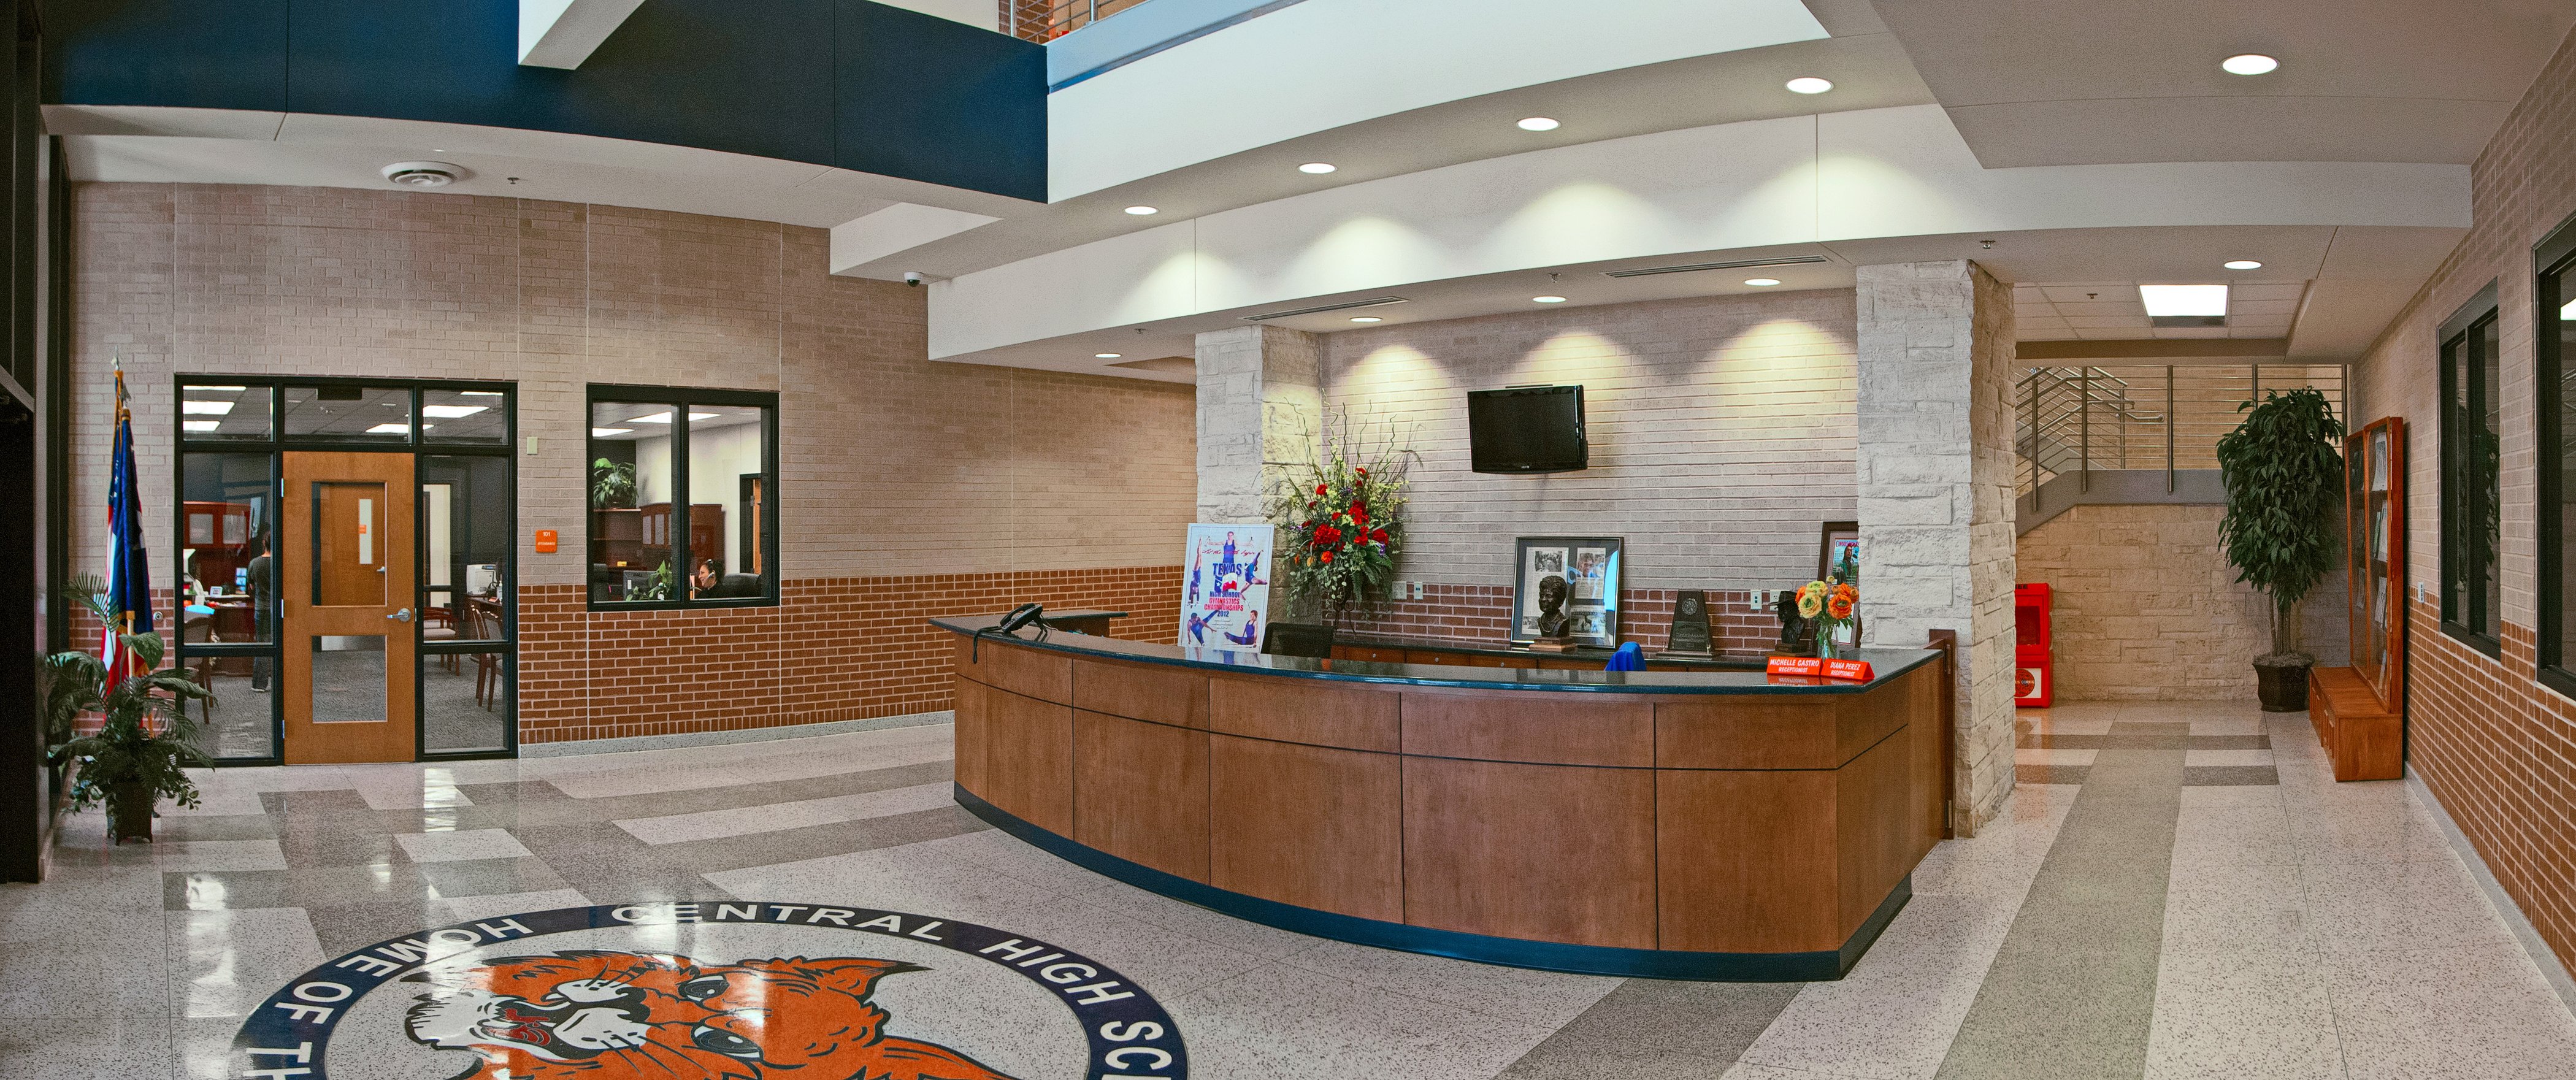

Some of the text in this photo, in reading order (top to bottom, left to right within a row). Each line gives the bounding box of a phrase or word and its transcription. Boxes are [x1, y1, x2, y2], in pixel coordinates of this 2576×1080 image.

[1213, 562, 1242, 576] TEXAS
[1845, 662, 1861, 671] PEREZ
[335, 919, 534, 978] HOME
[611, 904, 943, 941] CENTRAL
[978, 938, 1135, 1006] HIGH
[274, 981, 353, 1024] OF
